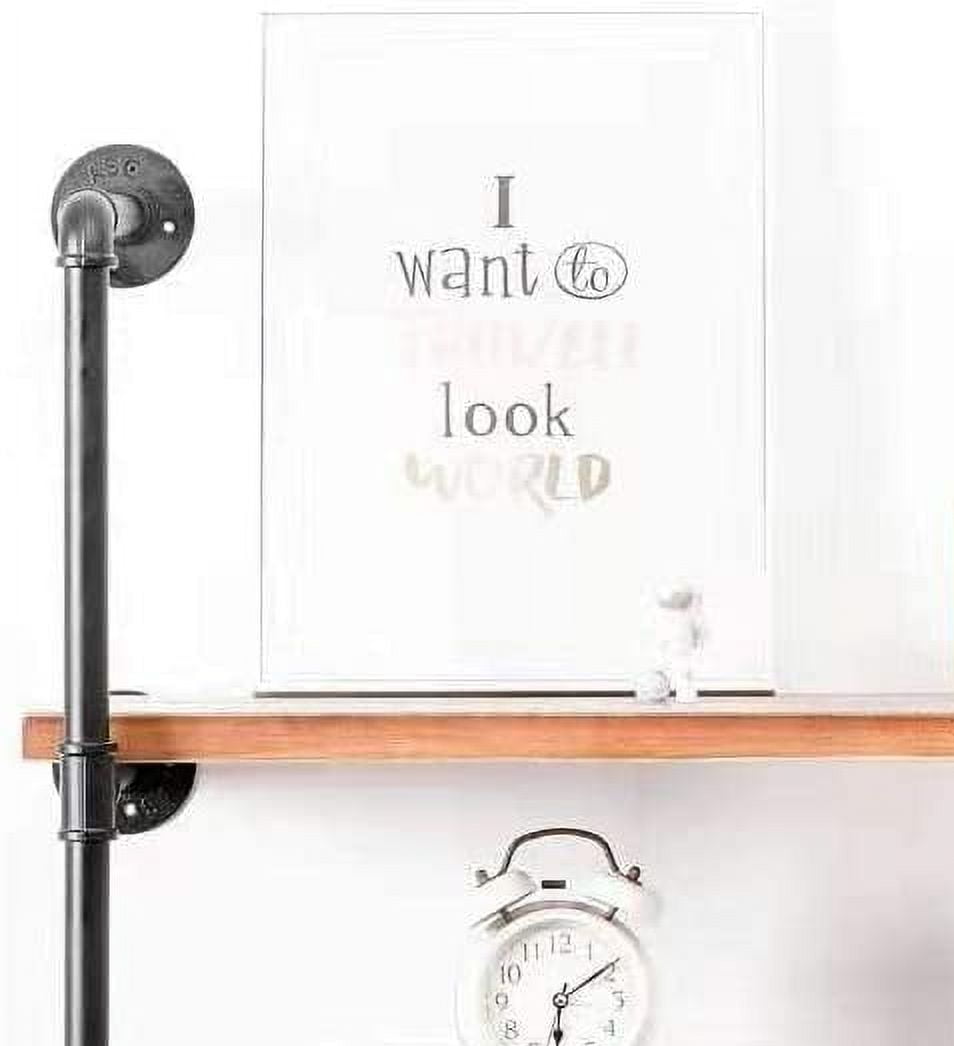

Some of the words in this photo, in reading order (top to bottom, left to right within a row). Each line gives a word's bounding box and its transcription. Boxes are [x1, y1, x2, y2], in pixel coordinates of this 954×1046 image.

[493, 175, 516, 229] I
[397, 243, 538, 299] want
[438, 381, 576, 438] look
[405, 452, 612, 520] WORLD
